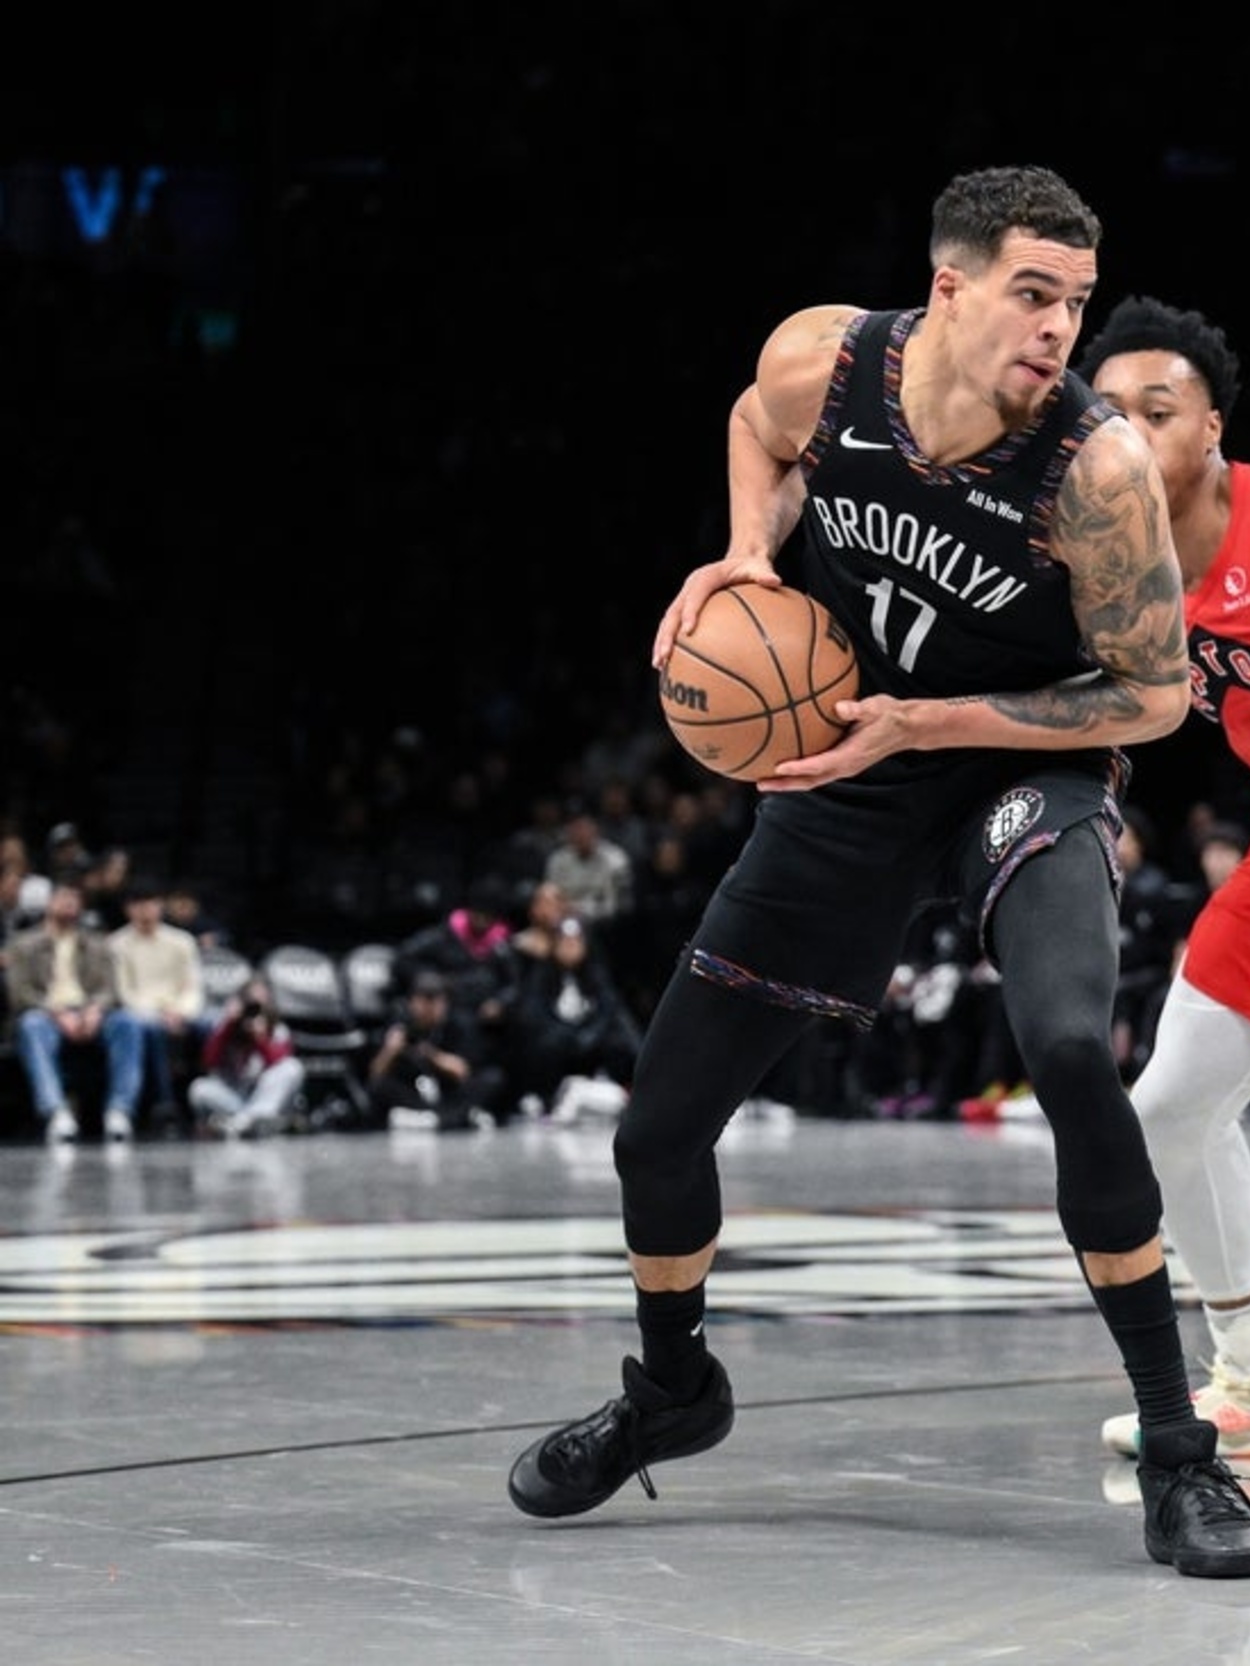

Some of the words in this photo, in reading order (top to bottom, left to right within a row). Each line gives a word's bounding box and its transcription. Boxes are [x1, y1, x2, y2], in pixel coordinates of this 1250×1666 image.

[966, 489, 985, 507] All
[813, 496, 1028, 613] BROOKLYN
[865, 576, 938, 674] 17
